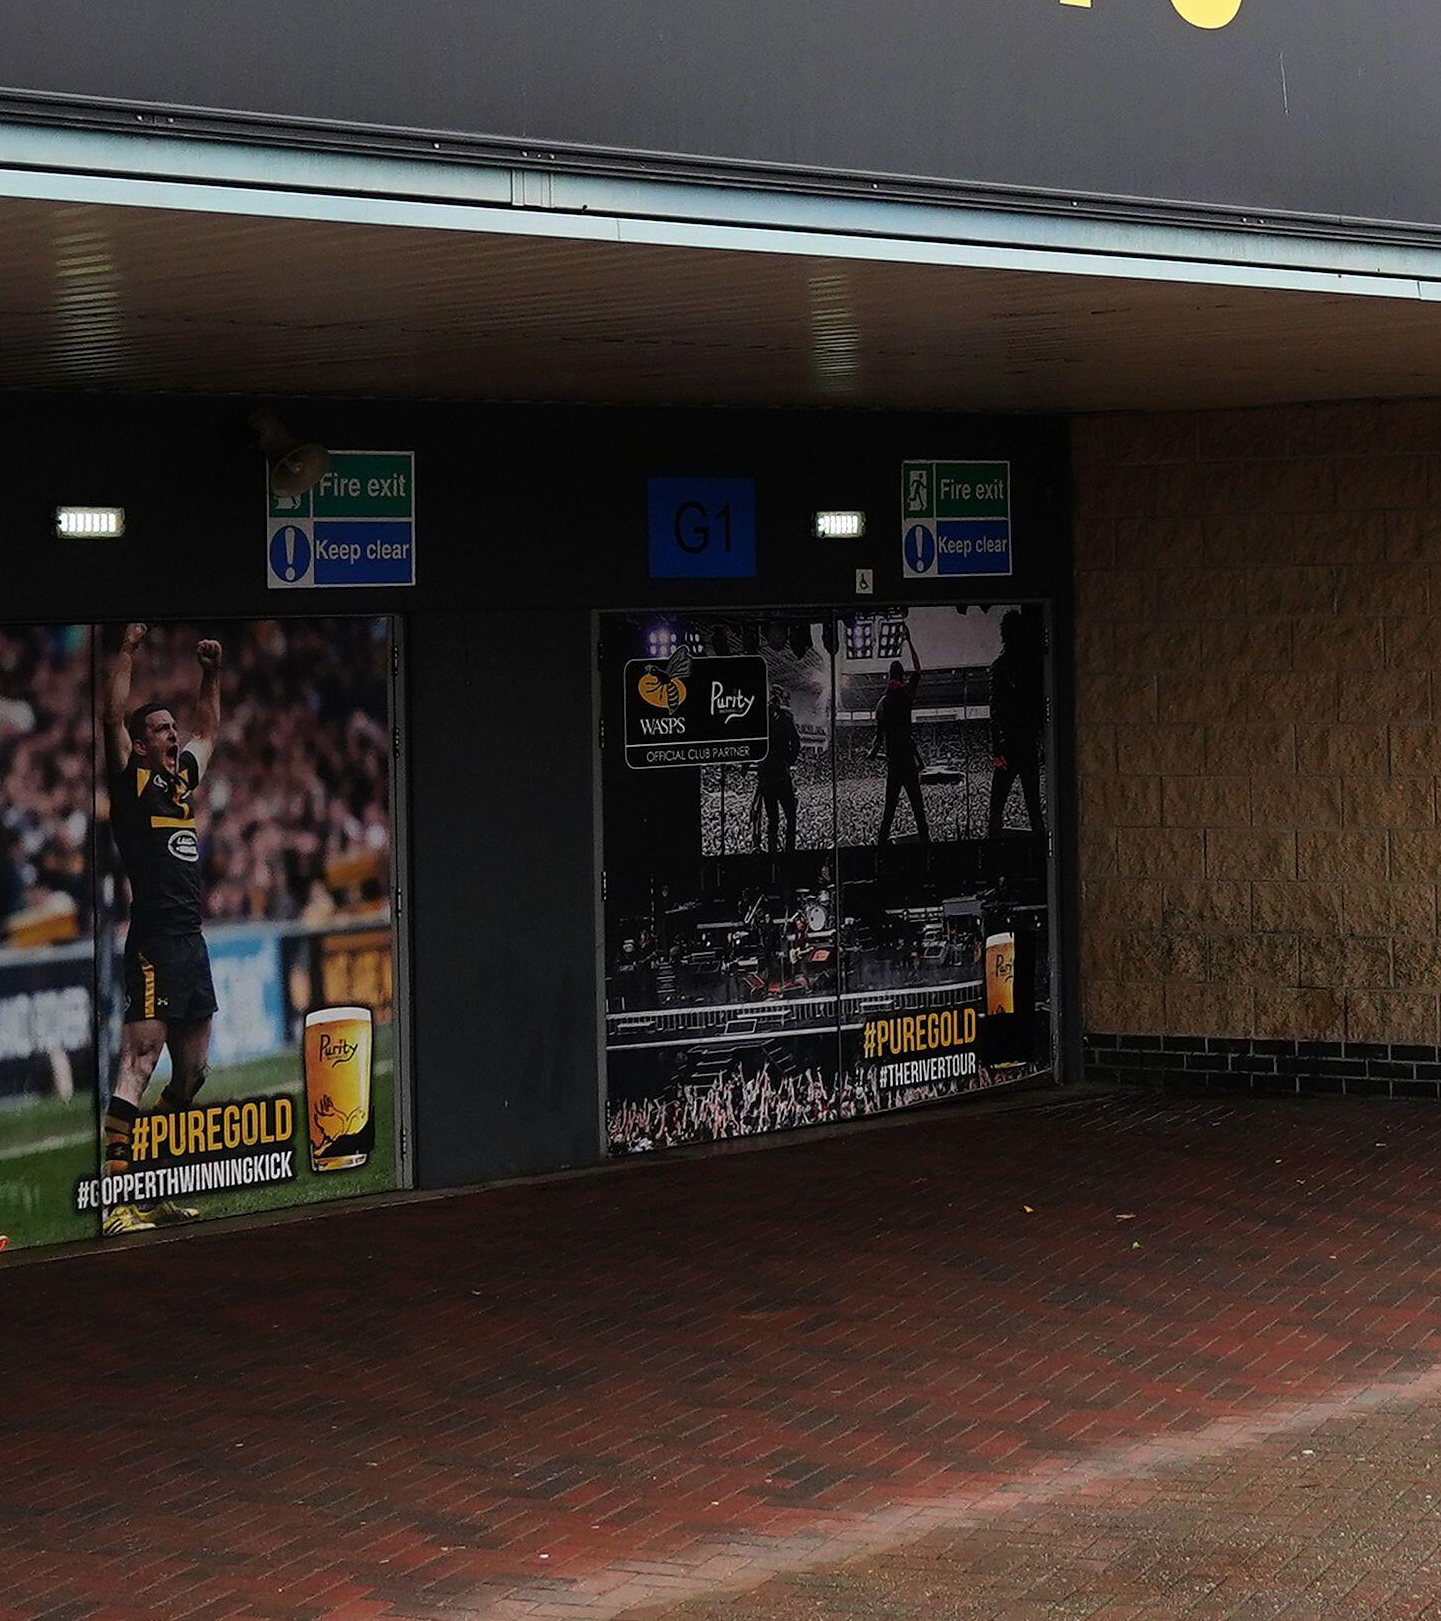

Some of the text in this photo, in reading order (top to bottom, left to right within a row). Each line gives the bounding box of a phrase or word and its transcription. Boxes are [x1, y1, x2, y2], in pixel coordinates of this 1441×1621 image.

[319, 473, 406, 497] Fire exit
[941, 478, 1005, 500] Fire exit
[675, 500, 731, 554] G1
[316, 540, 409, 565] Keep clear
[938, 535, 1007, 558] Keep clear
[710, 680, 755, 725] Purity
[639, 716, 687, 736] WASPS
[646, 745, 751, 763] OFFICIAL CLUB PARTNER
[862, 1007, 977, 1059] #PUREGOLD
[318, 1034, 359, 1068] Purity
[879, 1050, 977, 1089] #THERIVERTOUR
[130, 1097, 294, 1163] #PUREGOLD
[76, 1149, 294, 1210] #GOPPERTHWINNINGKICK
